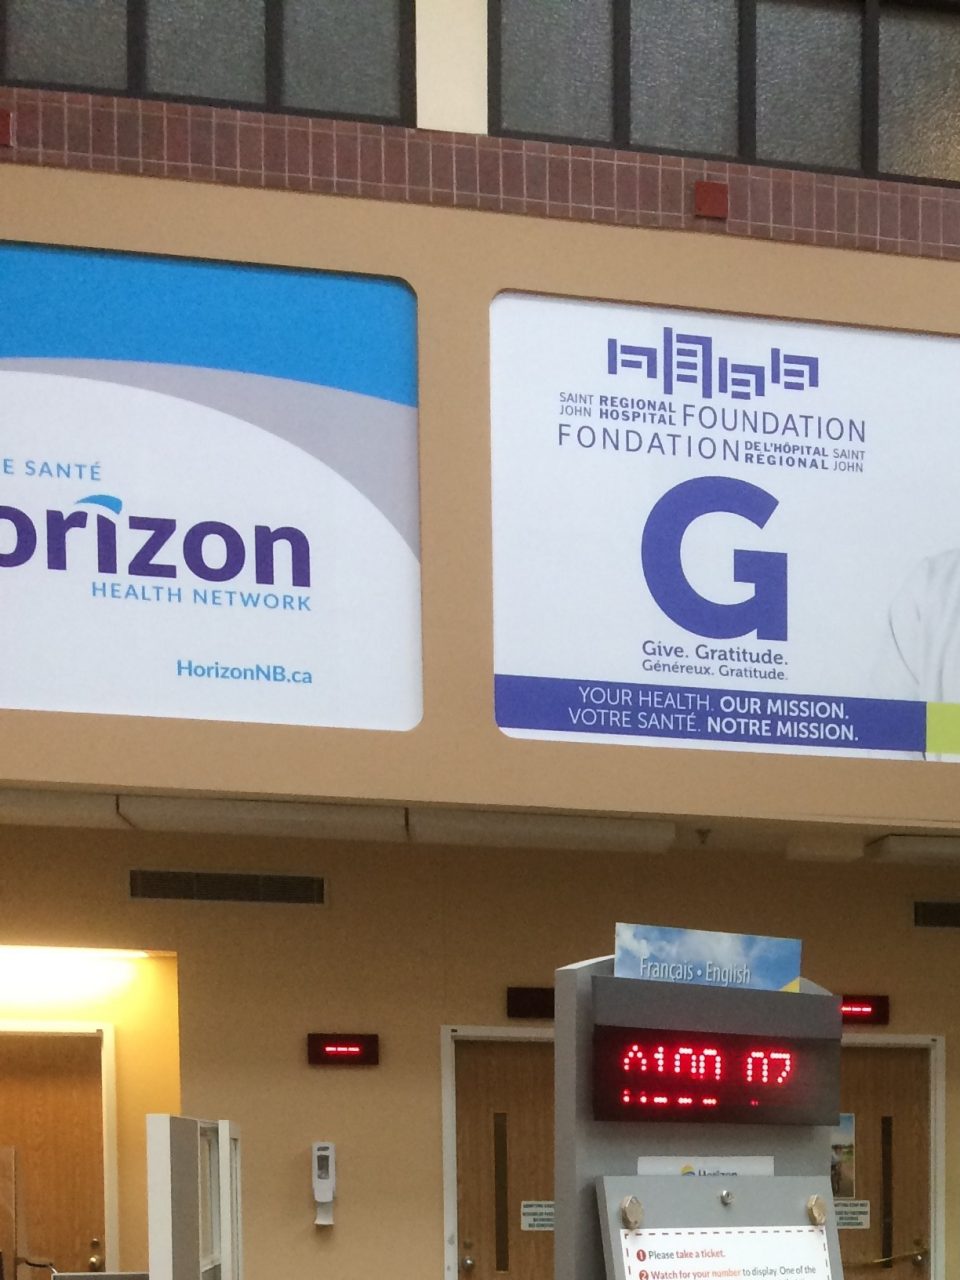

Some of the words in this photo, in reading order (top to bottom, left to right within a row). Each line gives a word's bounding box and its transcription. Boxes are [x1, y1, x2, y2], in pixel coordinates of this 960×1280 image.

[560, 392, 594, 405] SAINT
[599, 395, 677, 414] REGIONAL
[560, 404, 592, 418] JOHN
[599, 407, 677, 427] HOSPITAL
[683, 404, 866, 443] FOUNDATION
[558, 423, 740, 462] FONDATION
[744, 440, 762, 452] DE
[833, 448, 865, 461] SAINT
[26, 459, 102, 481] SANTÉ
[744, 451, 828, 471] RÉGIONAL
[833, 460, 864, 473] JOHN
[641, 476, 788, 641] G
[92, 581, 182, 603] HEALTH
[194, 589, 312, 611] NETWORK
[642, 640, 689, 659] Give.
[695, 645, 788, 666] Gratitude.
[177, 660, 312, 684] HorizonNB.ca
[642, 659, 715, 676] Généreux.
[719, 664, 788, 680] Gratitude.
[579, 686, 632, 706] YOUR
[639, 690, 714, 711] HEALTH.
[720, 696, 761, 714] OUR
[767, 699, 849, 719] MISSION.
[569, 708, 632, 727] VOTRE
[638, 711, 700, 732] SANTÉ.
[707, 718, 771, 737] NOTRE
[777, 721, 858, 741] MISSION.
[640, 957, 693, 982] Français
[706, 961, 750, 986] English
[648, 1250, 674, 1260] Please
[676, 1249, 693, 1259] take
[701, 1248, 726, 1258] ticket.
[650, 1270, 678, 1280] Watch
[679, 1270, 690, 1279] for
[692, 1271, 710, 1280] your
[711, 1268, 741, 1277] number
[742, 1268, 751, 1276] to
[779, 1265, 795, 1275] One
[795, 1265, 803, 1274] of
[804, 1265, 816, 1274] the
